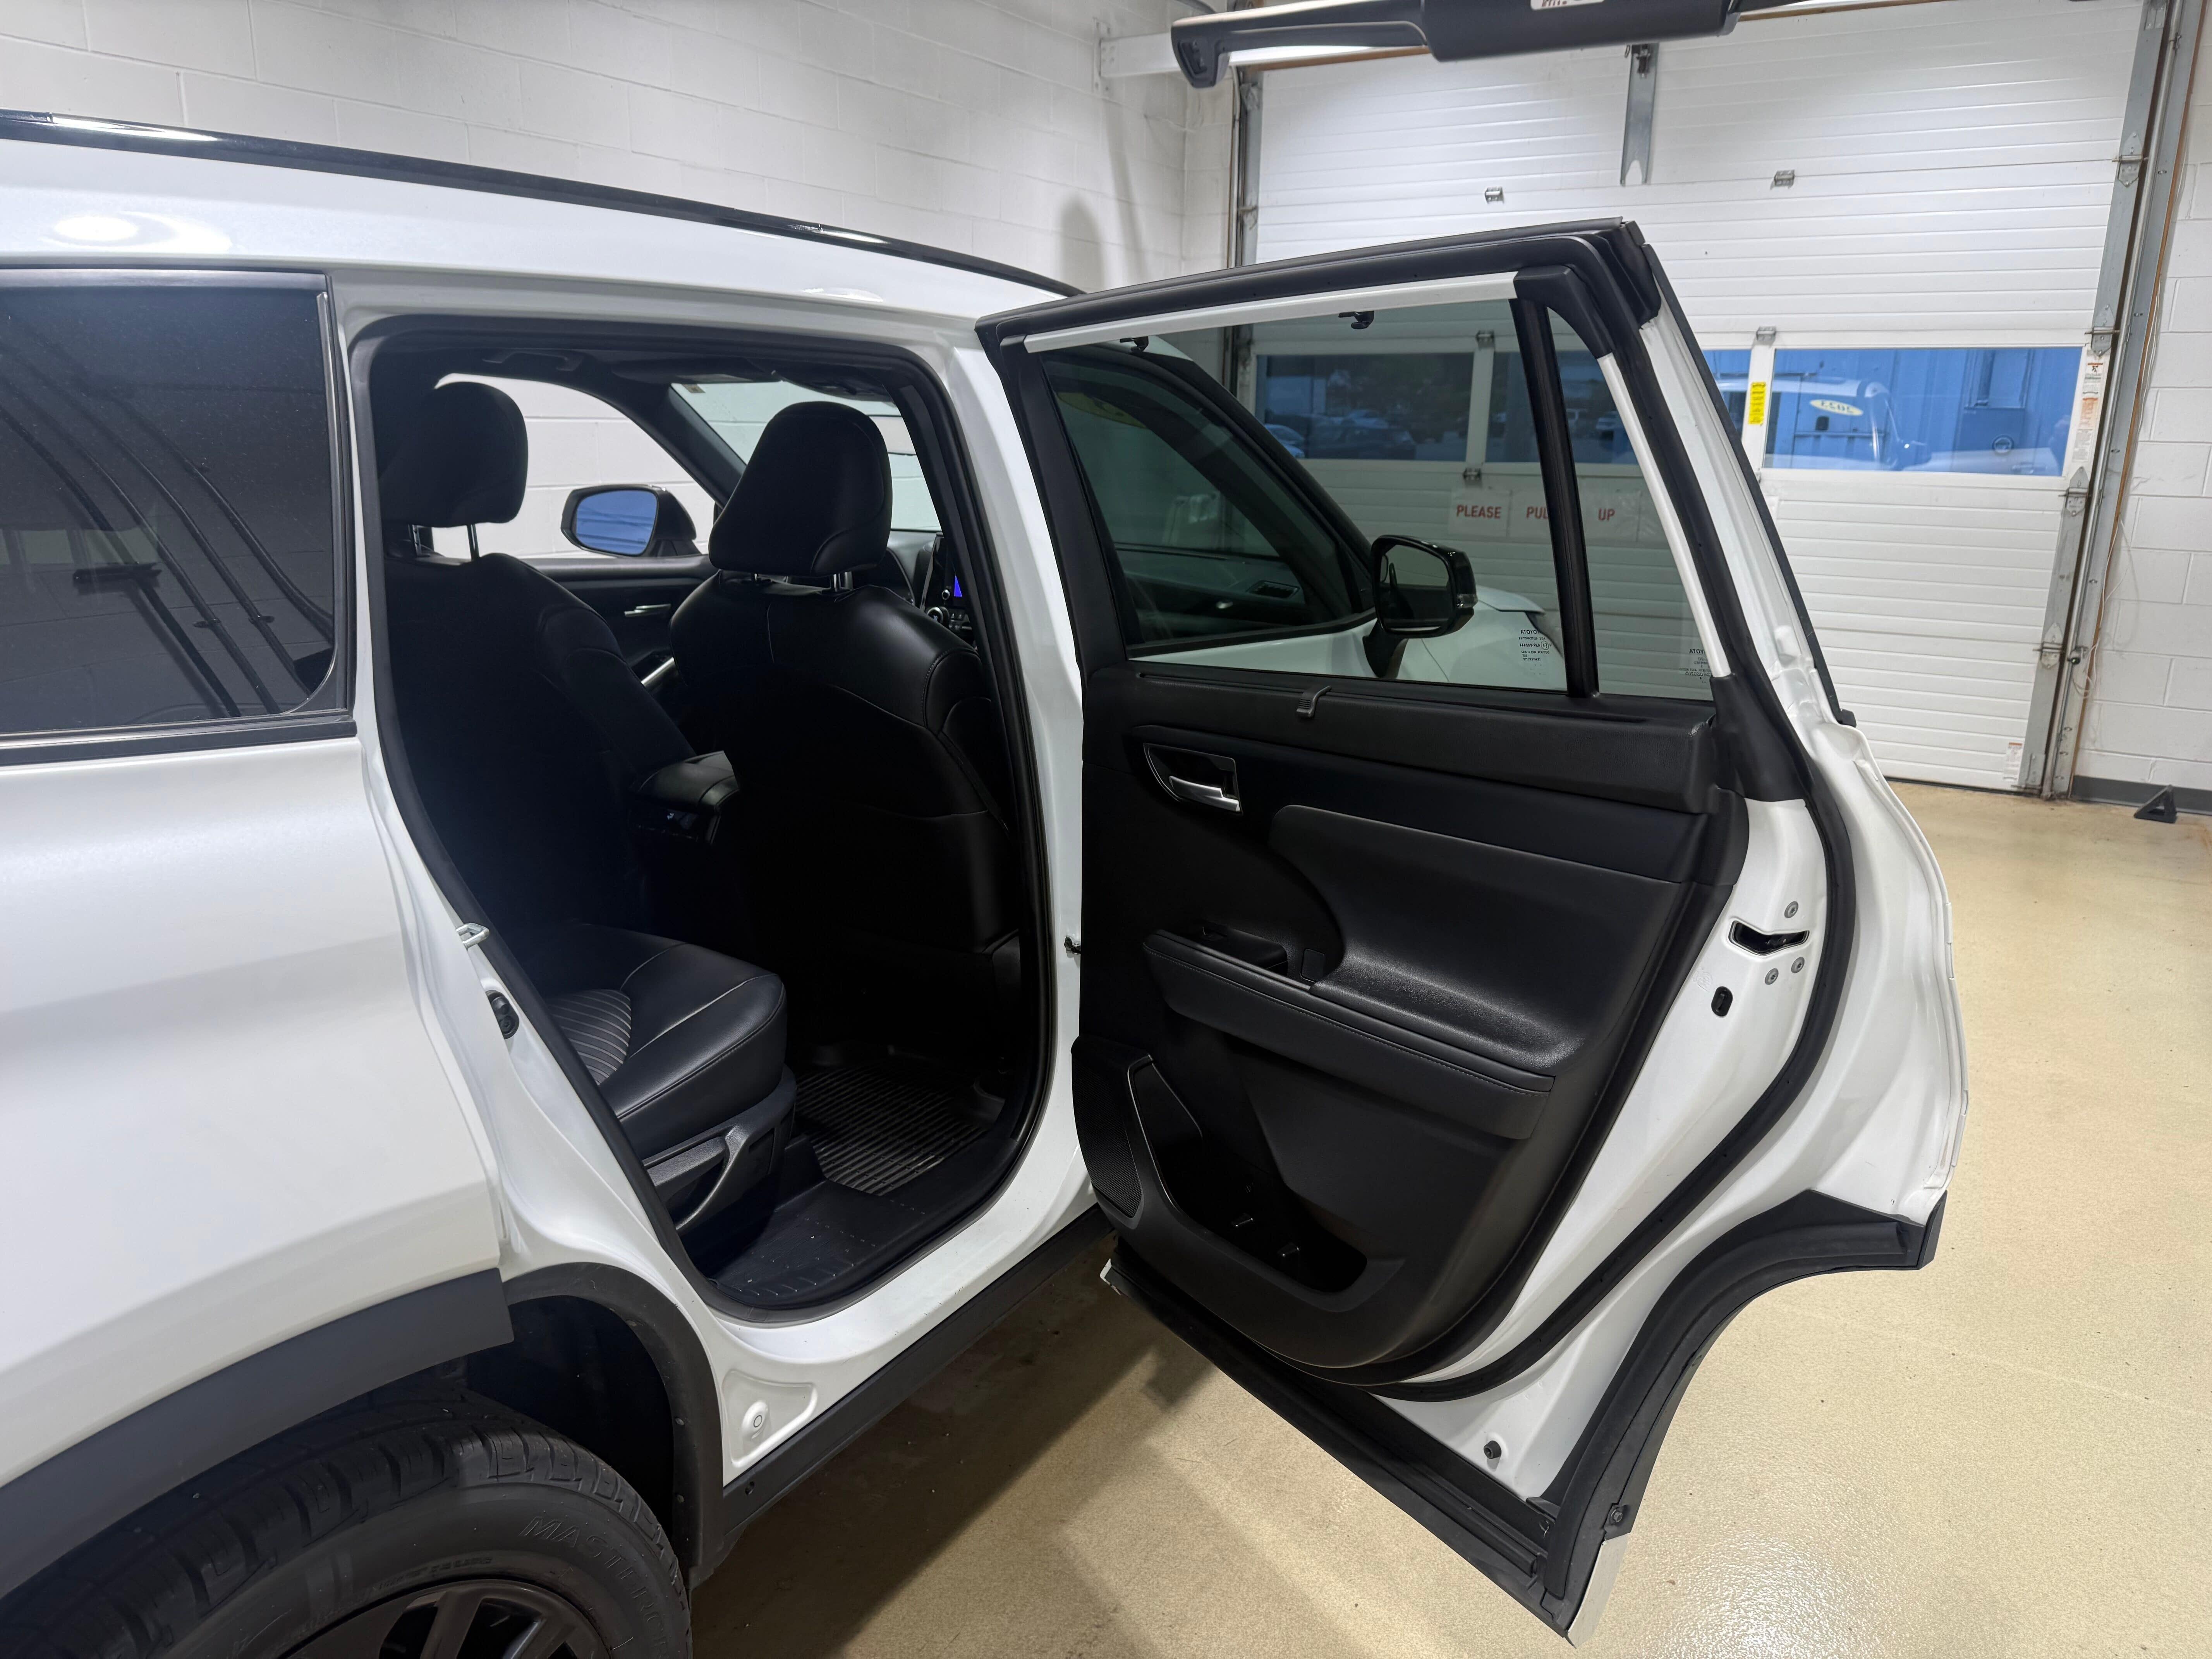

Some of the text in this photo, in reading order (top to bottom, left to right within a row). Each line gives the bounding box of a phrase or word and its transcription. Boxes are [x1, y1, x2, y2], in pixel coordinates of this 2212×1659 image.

[1456, 505, 1615, 521] PLEASE PUL UP
